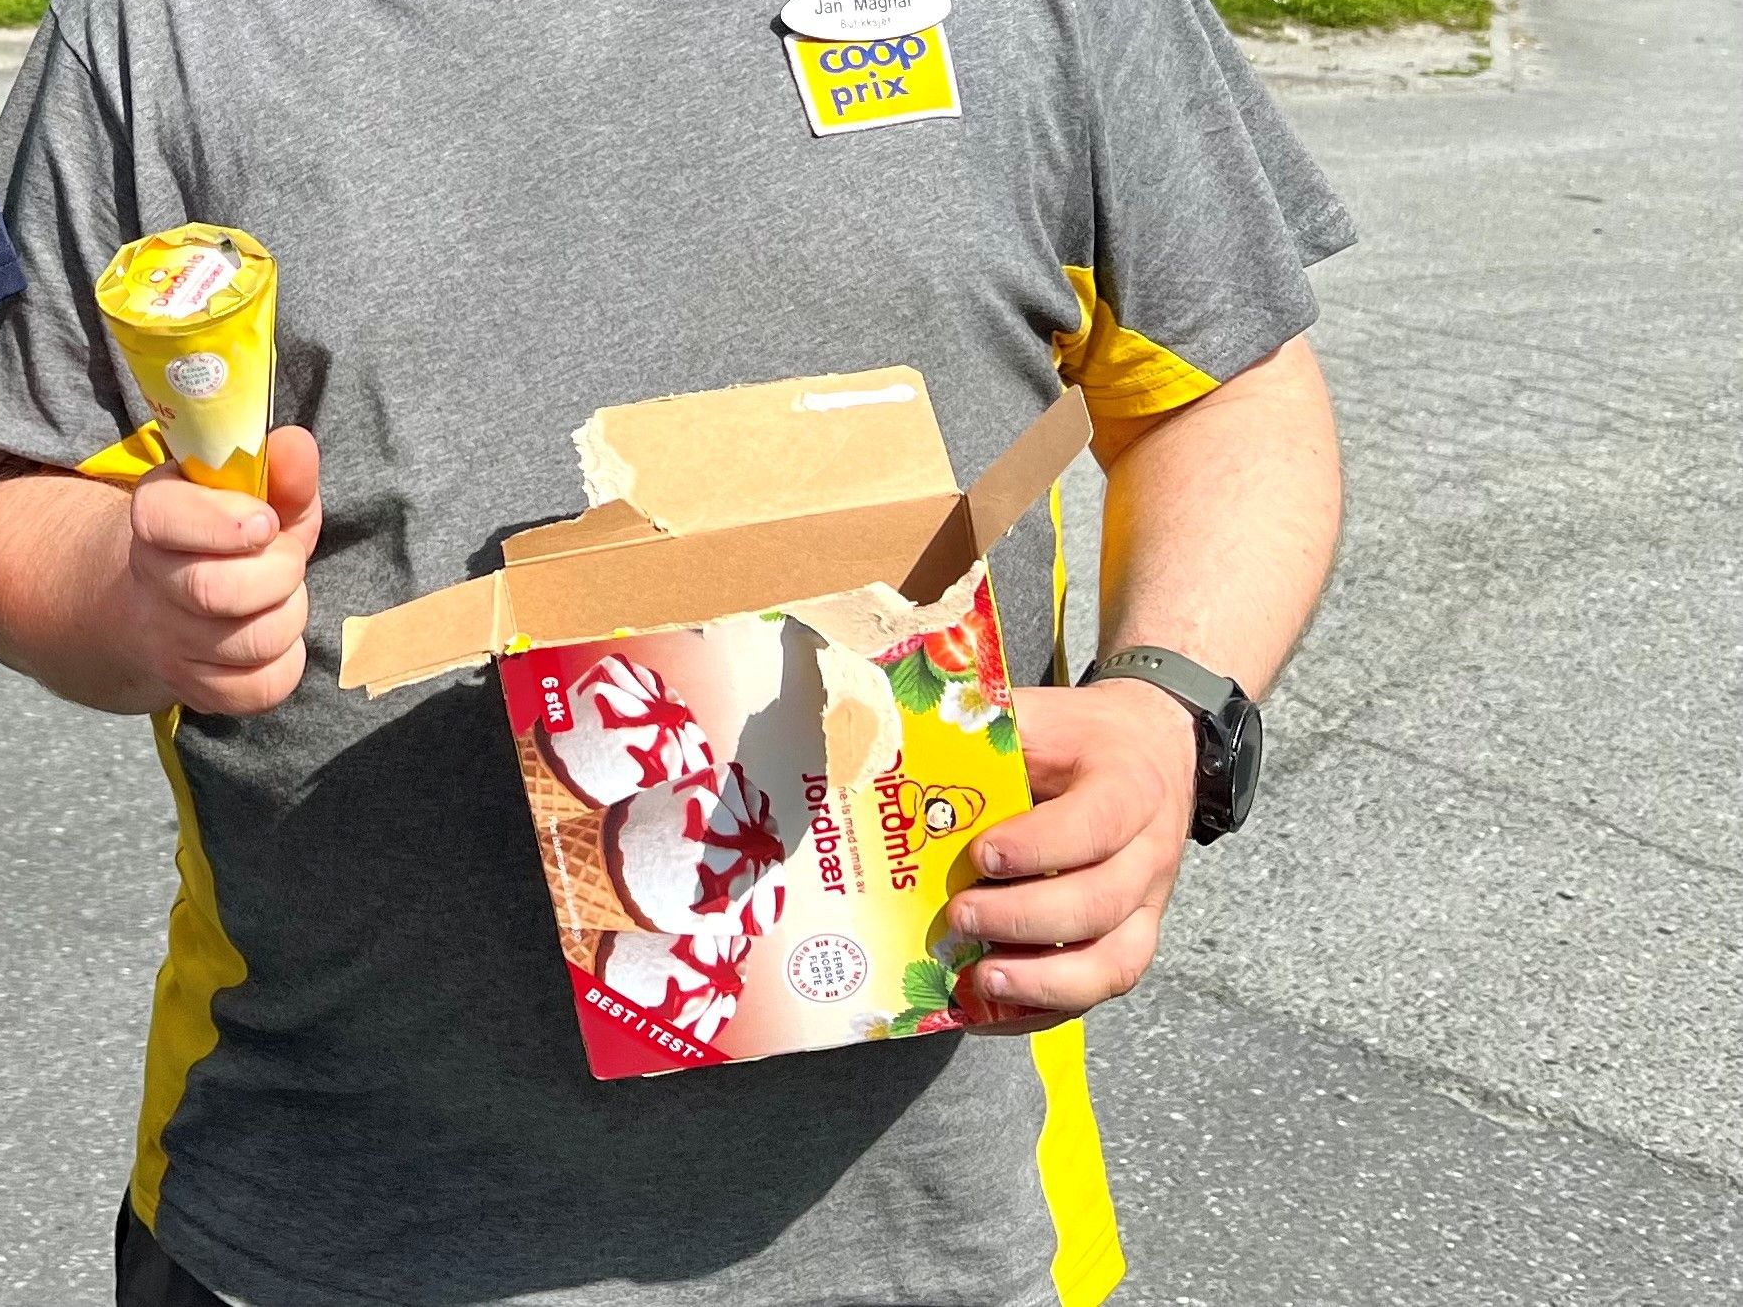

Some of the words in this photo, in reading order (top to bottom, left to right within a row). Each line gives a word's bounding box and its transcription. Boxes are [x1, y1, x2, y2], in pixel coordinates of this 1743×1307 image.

[819, 35, 926, 73] coop
[830, 71, 910, 116] prix
[541, 676, 559, 689] 6
[544, 691, 566, 724] stk
[801, 773, 846, 895] Jordbær
[843, 817, 857, 844] med
[849, 846, 865, 878] smak
[820, 951, 834, 986] NORSK
[833, 950, 845, 983] FERSK
[584, 987, 637, 1024] BEST
[635, 1018, 647, 1031] I
